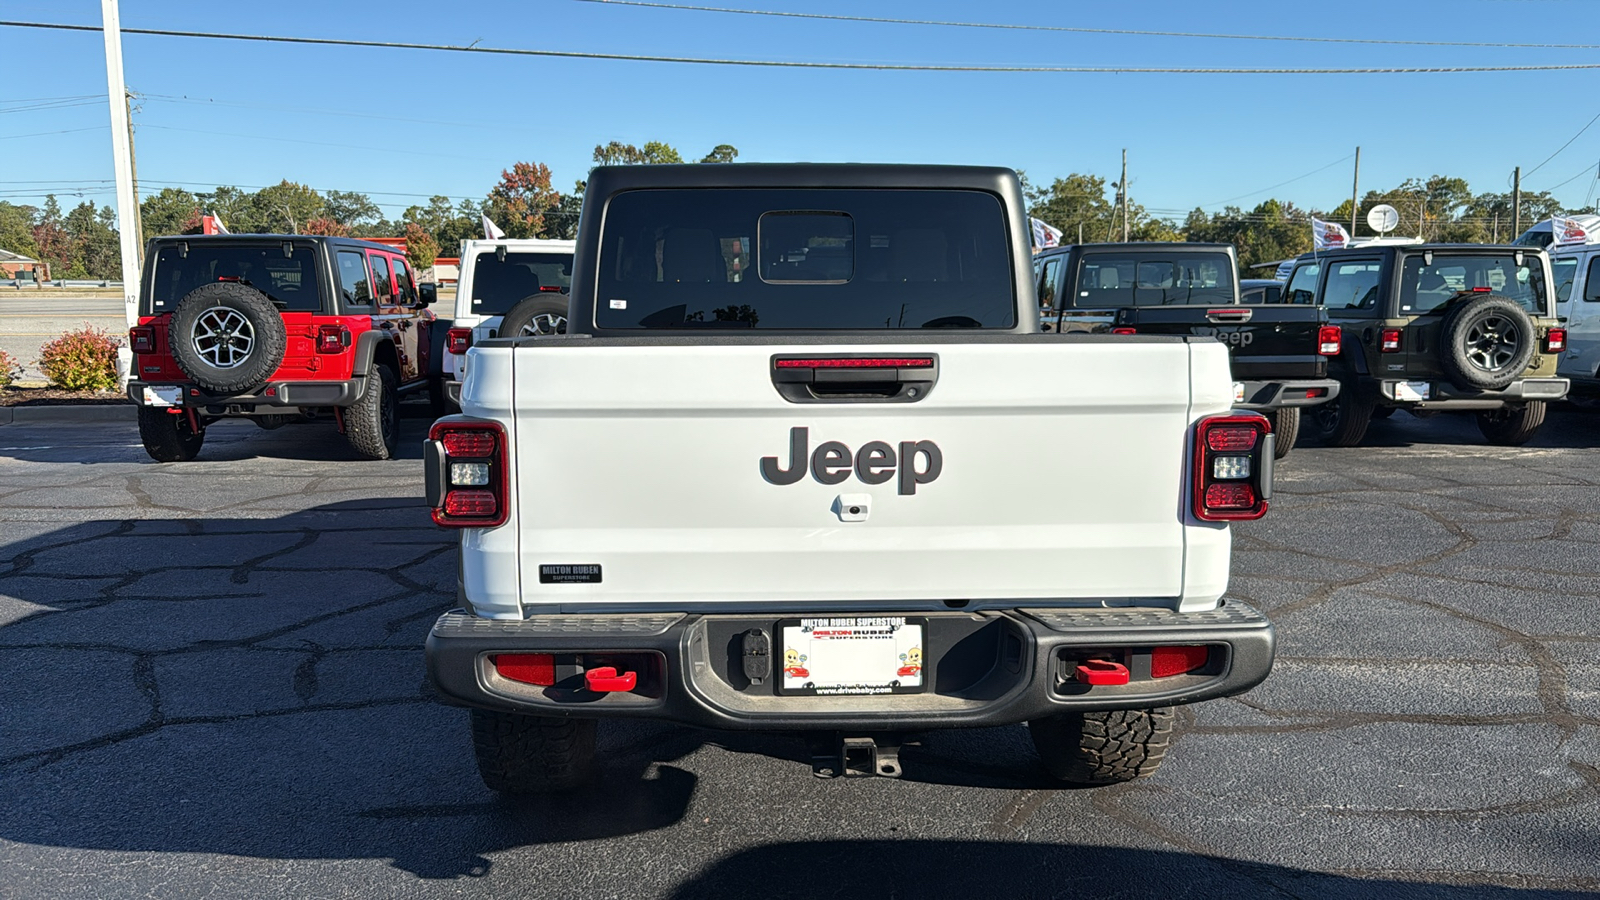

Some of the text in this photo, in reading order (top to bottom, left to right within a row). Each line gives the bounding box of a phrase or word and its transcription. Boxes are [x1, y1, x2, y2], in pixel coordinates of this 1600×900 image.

[126, 295, 136, 304] A2
[759, 426, 943, 496] Jeep
[542, 566, 599, 575] MILTON RUBEN
[801, 617, 906, 627] MILTON RUBEN SUPERSTORE
